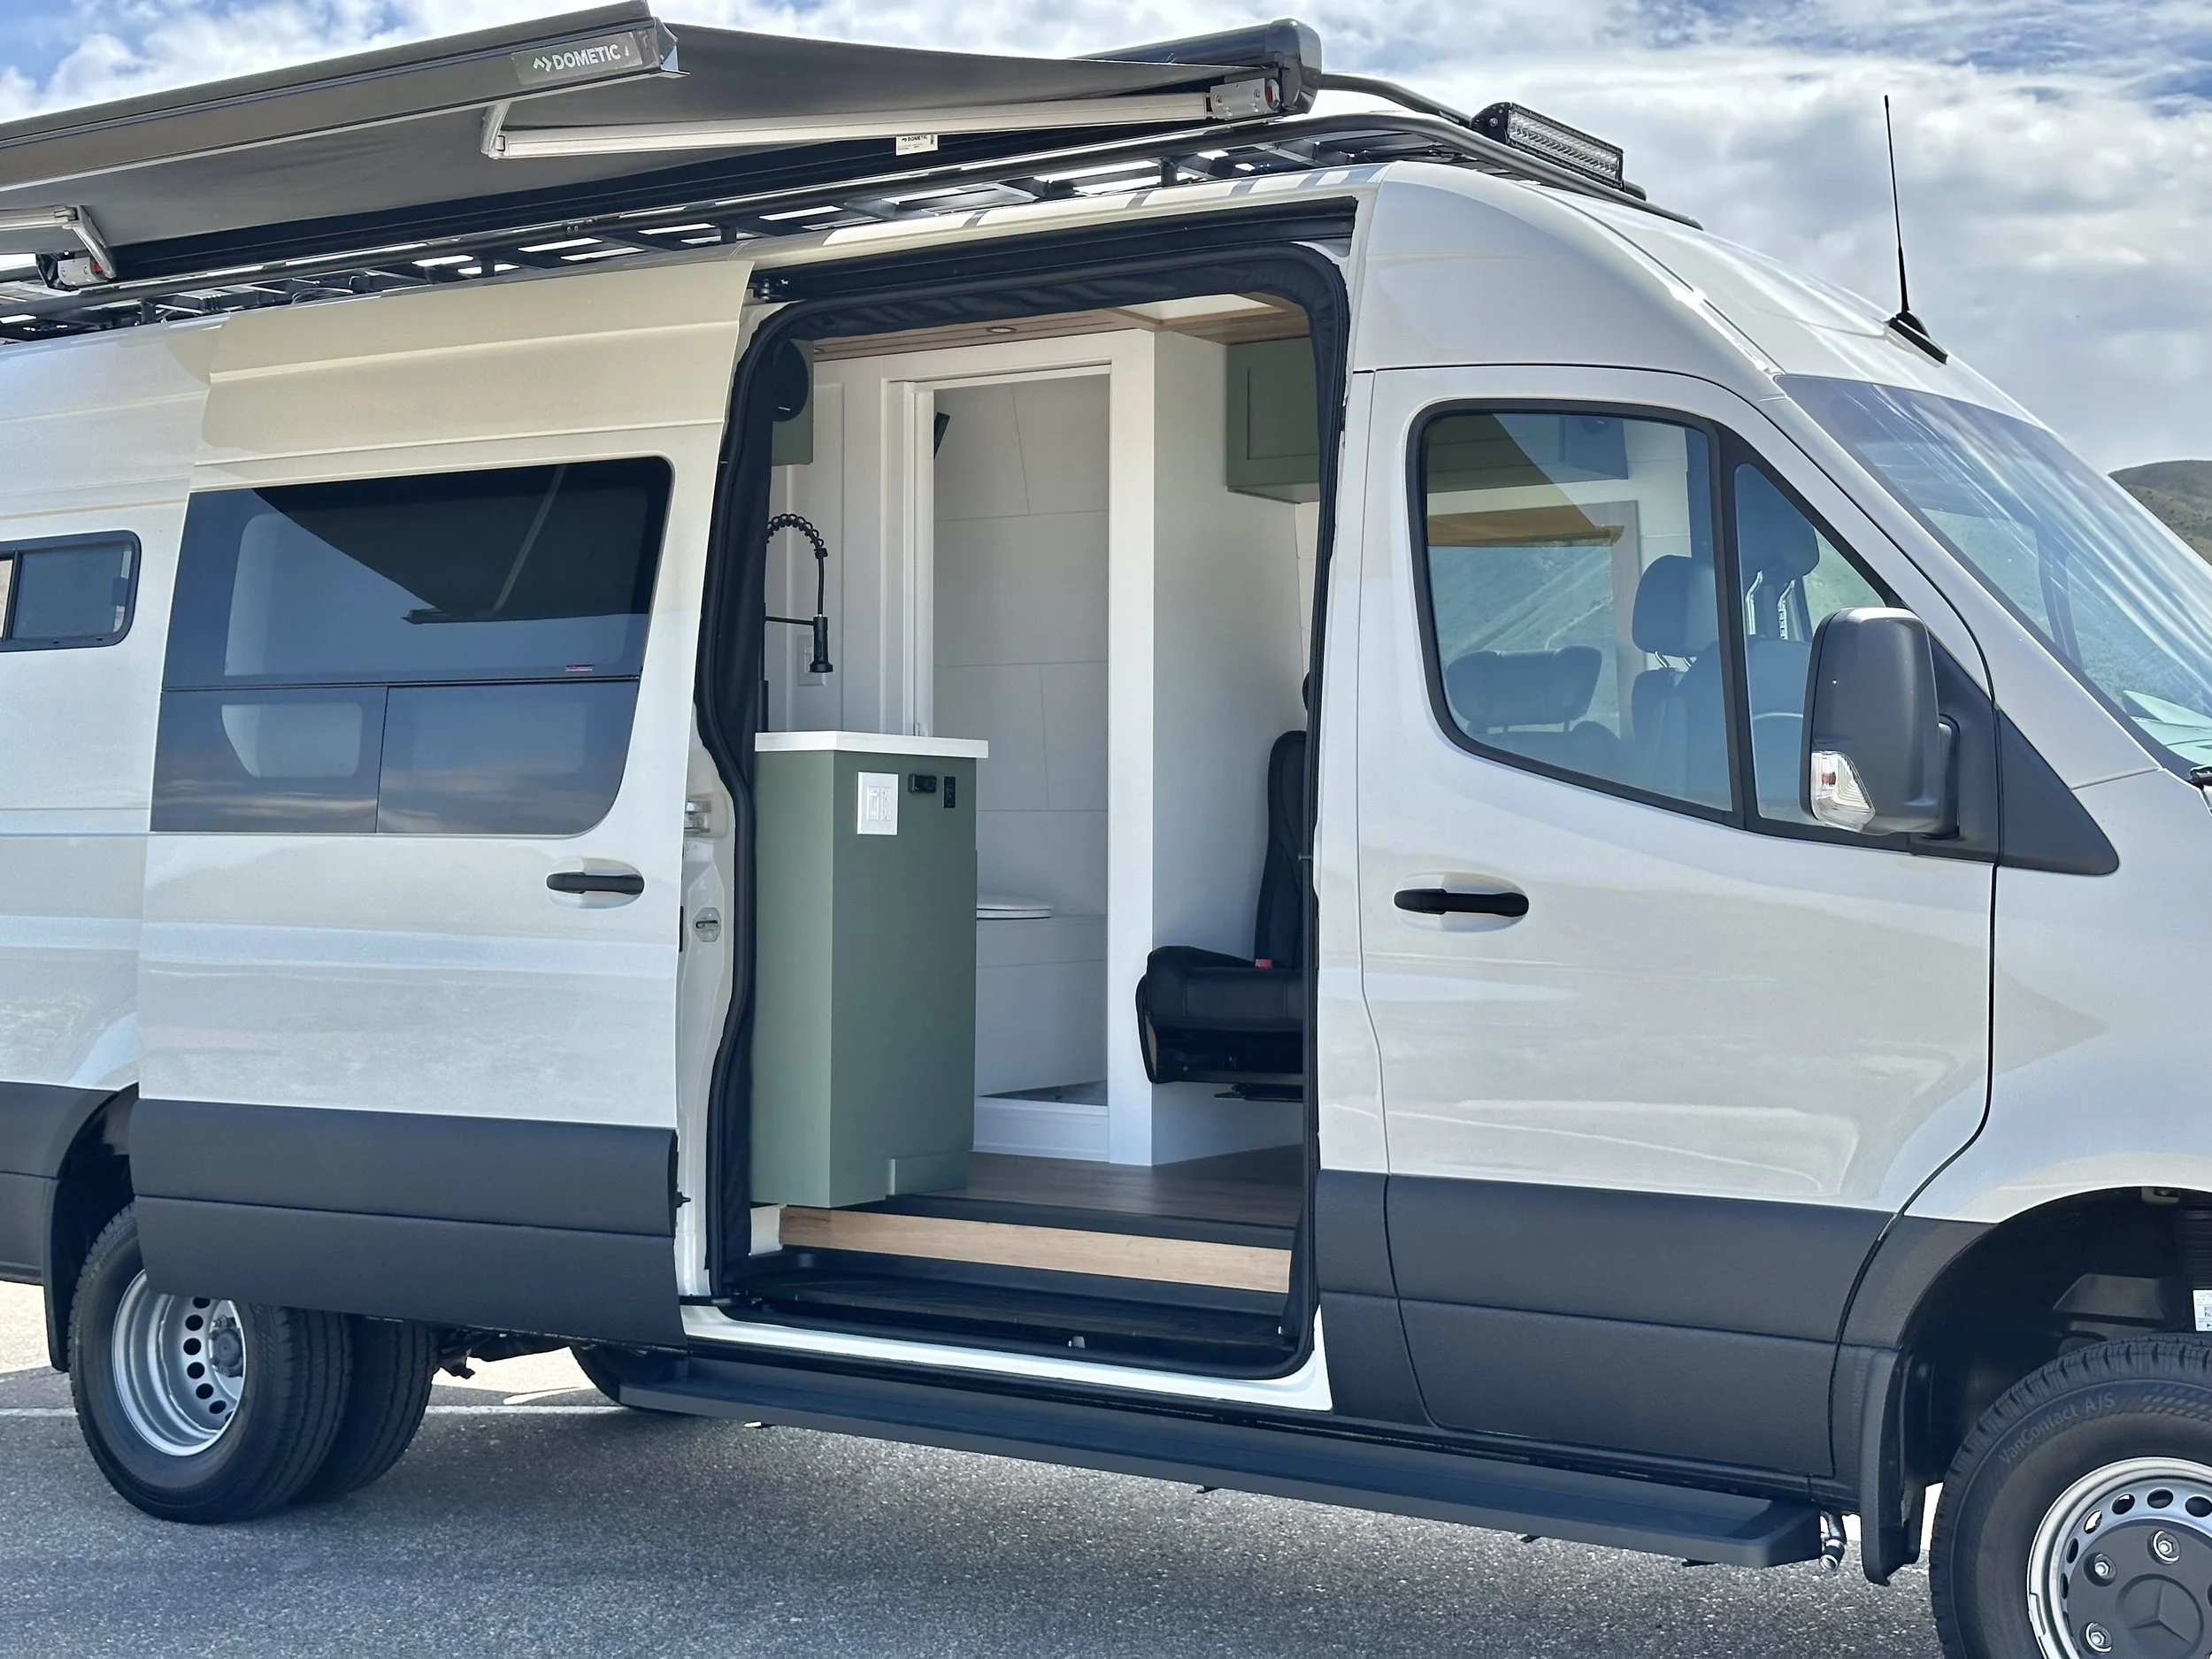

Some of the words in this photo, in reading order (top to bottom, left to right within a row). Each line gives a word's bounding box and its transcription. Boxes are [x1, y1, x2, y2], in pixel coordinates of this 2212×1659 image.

[551, 43, 621, 71] DOMETIC
[1998, 1404, 2078, 1464] VanContact
[2085, 1392, 2116, 1413] A/S
